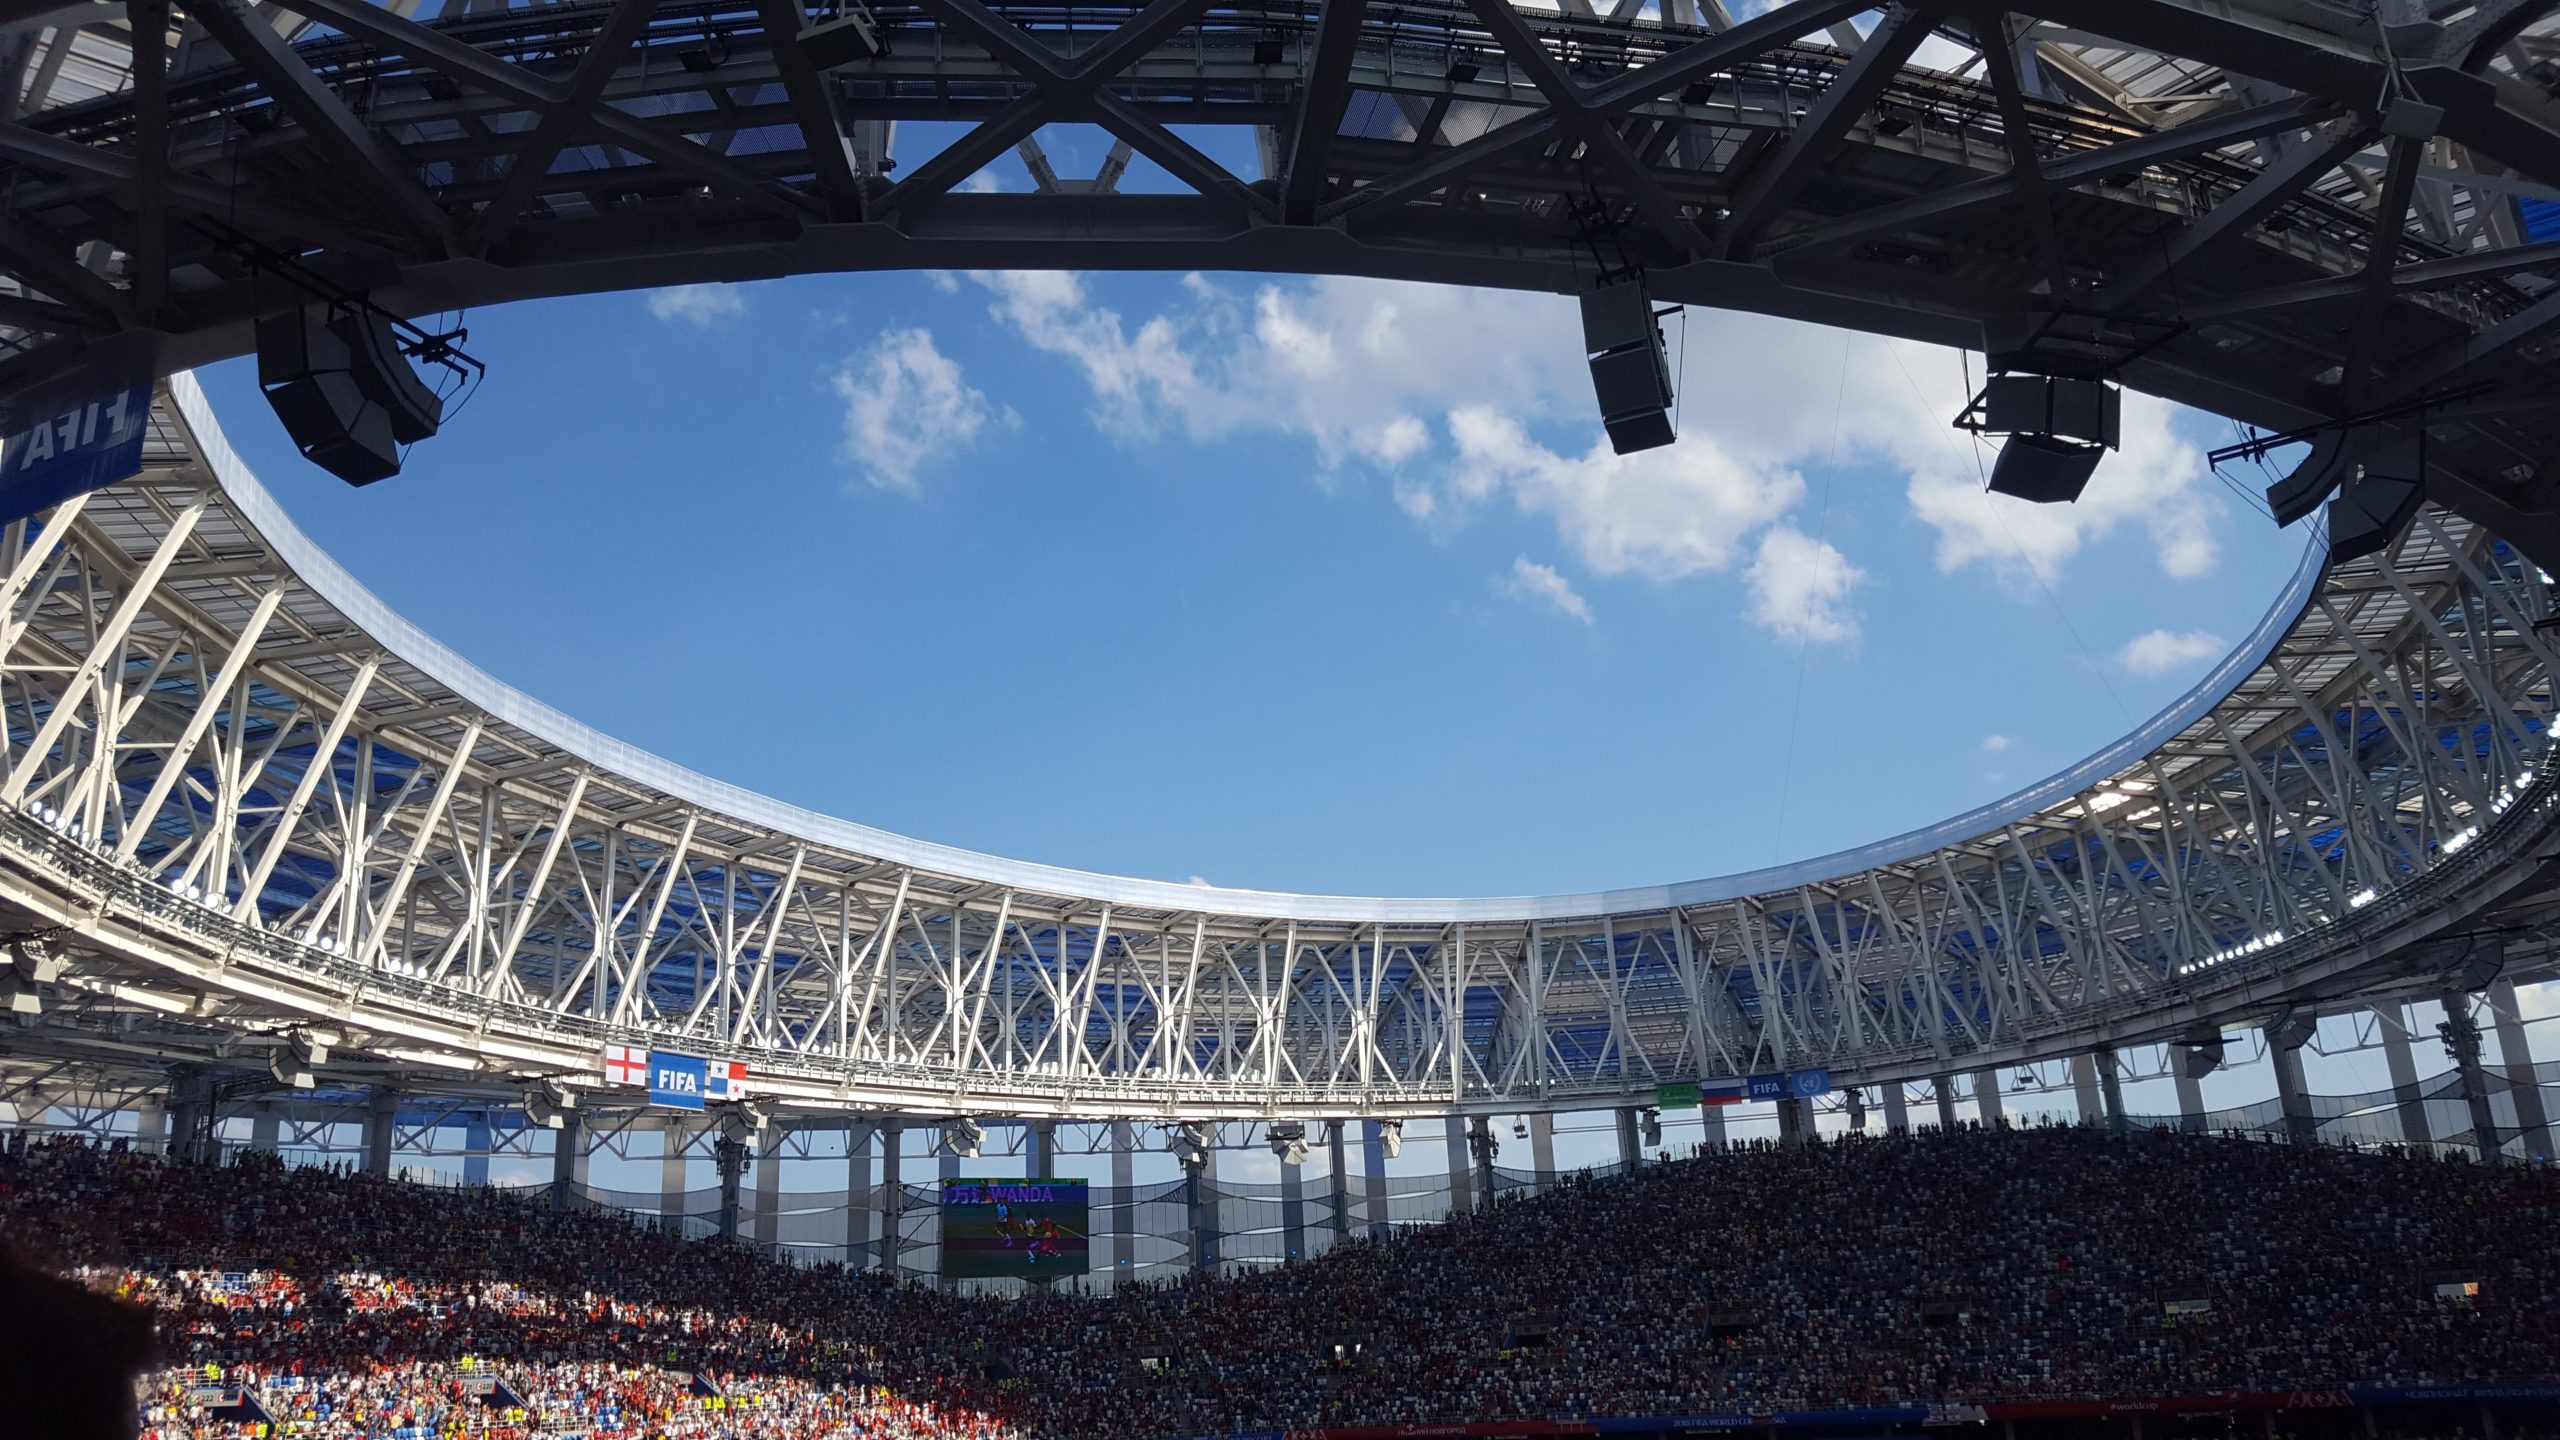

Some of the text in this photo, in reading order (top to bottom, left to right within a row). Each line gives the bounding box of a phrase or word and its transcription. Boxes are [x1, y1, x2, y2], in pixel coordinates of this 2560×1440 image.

[658, 1069, 697, 1093] FIFA
[1753, 1082, 1780, 1095] FIFA
[990, 1186, 1054, 1203] WANDA
[2110, 1401, 2158, 1412] #worldcup
[1692, 1418, 1709, 1427] FIFA
[1709, 1418, 1738, 1426] WORLD
